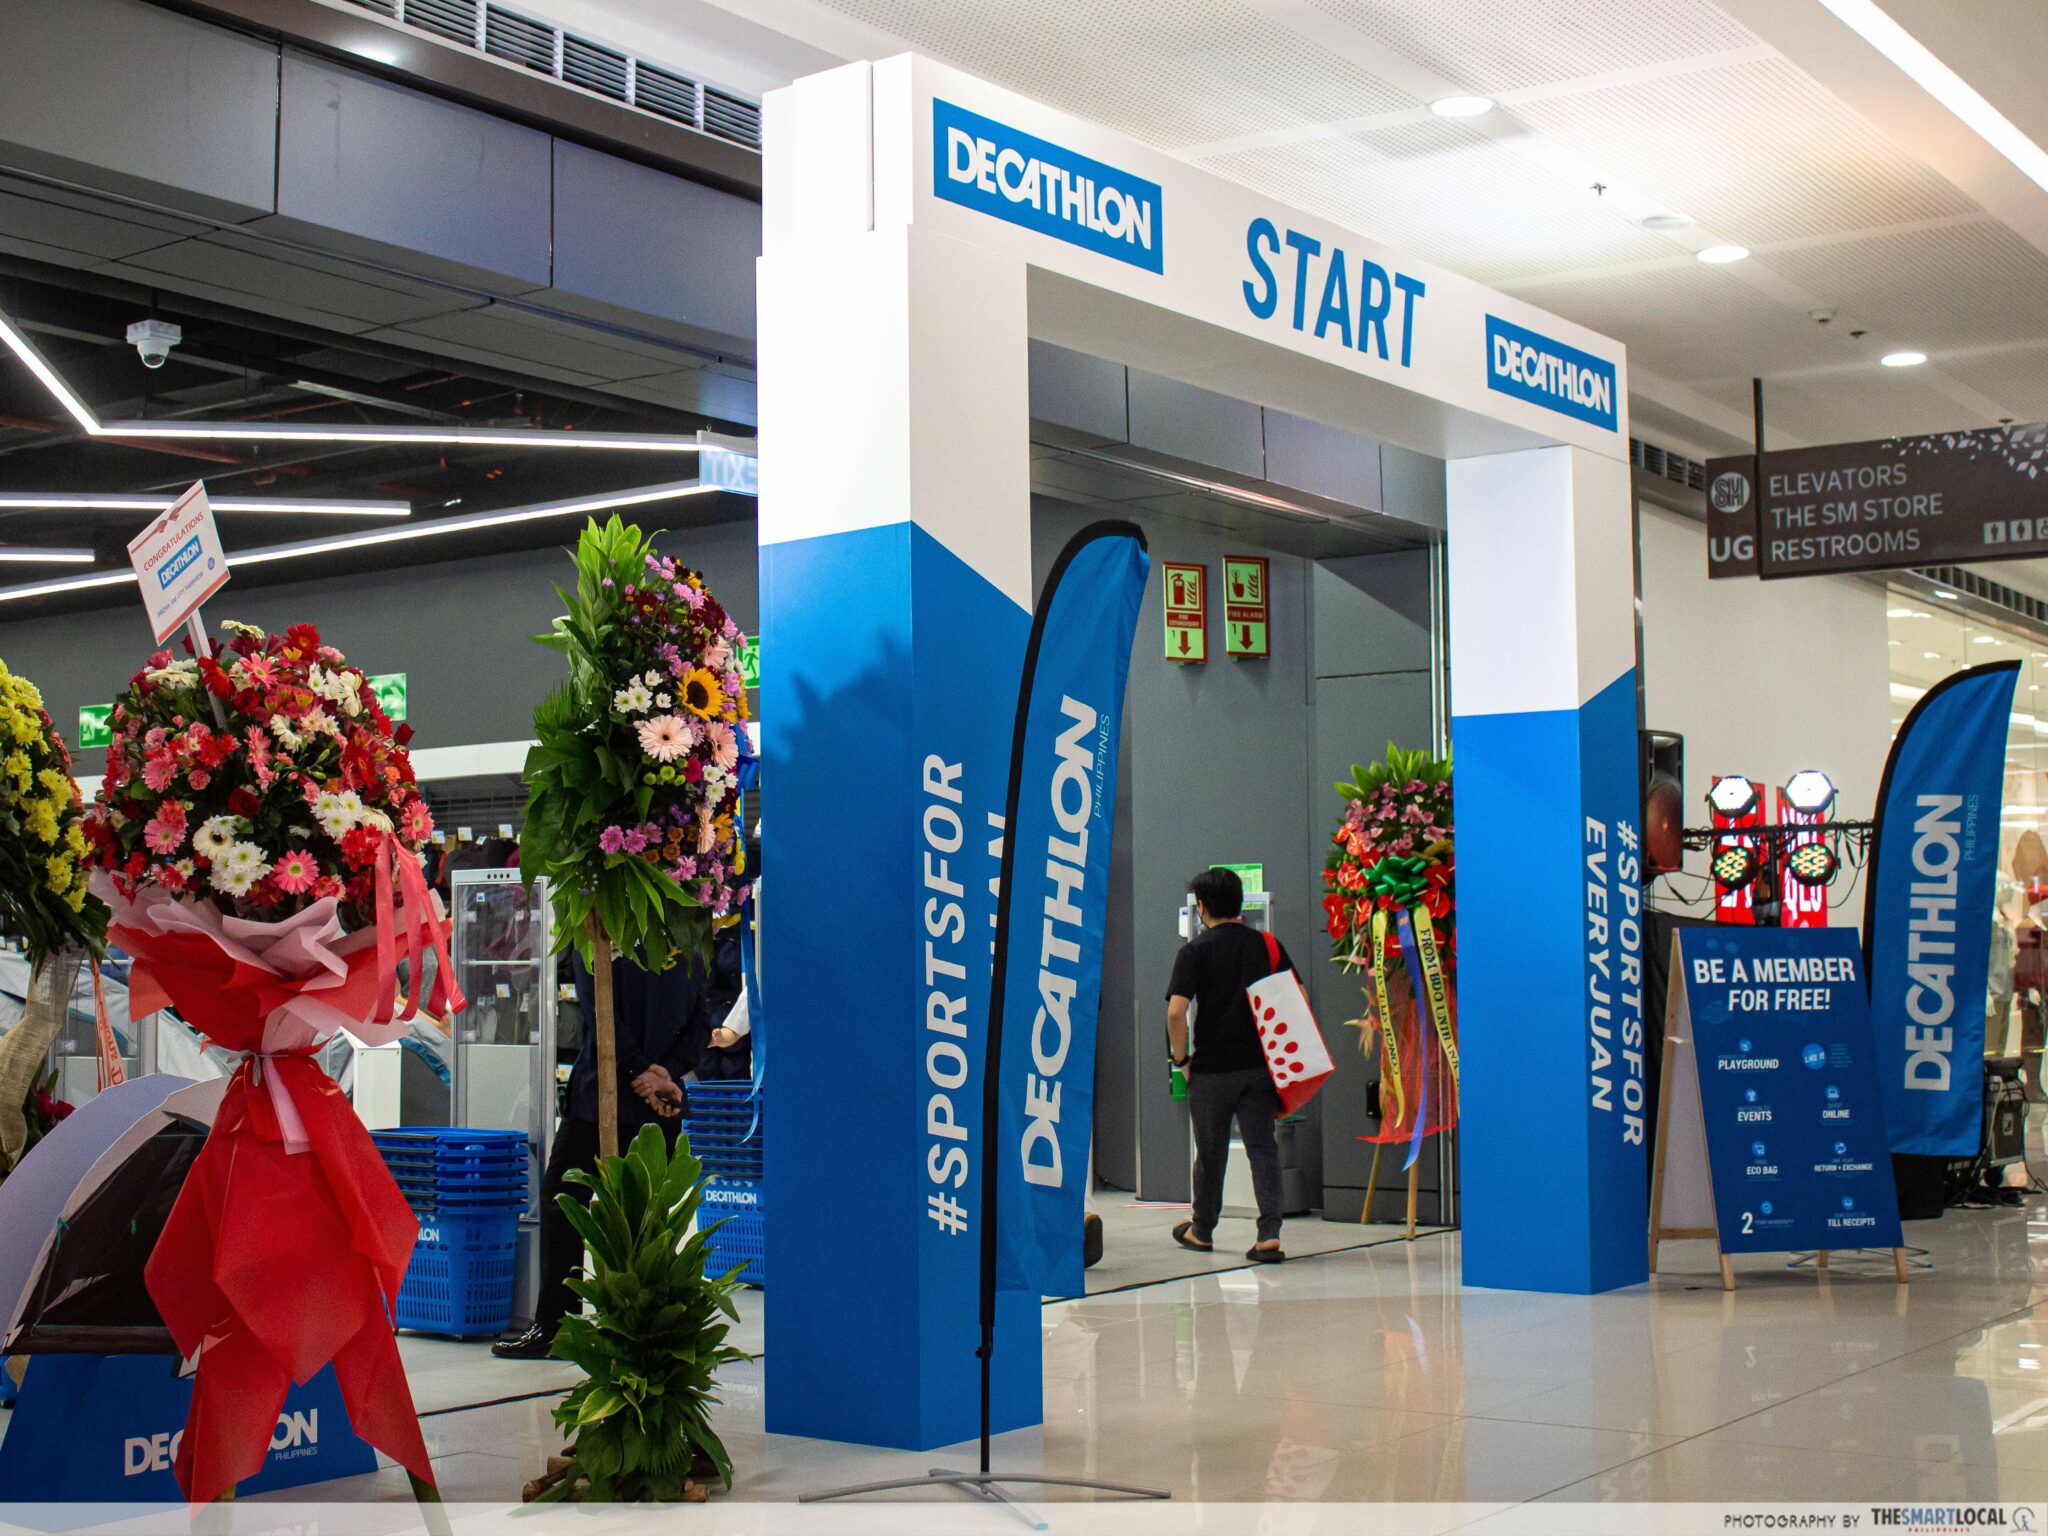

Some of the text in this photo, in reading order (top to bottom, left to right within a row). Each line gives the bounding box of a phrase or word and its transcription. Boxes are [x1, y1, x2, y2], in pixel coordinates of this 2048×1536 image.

[947, 126, 1153, 251] DECATHLON
[1242, 217, 1426, 369] START
[1494, 335, 1611, 415] DECATHLON
[1769, 464, 1908, 497] ELEVATORS
[1771, 493, 1944, 529] THE SM STORE
[144, 511, 204, 571] CONGRATULATIONS
[1710, 535, 1754, 562] UG
[1772, 528, 1921, 562] RESTROOMS
[161, 541, 199, 586] DECATHLON
[1093, 713, 1110, 818] PHILIPPINES
[1964, 793, 1979, 862] PHILIPPINES
[1021, 694, 1098, 1188] DECATHLON
[1904, 794, 1964, 1091] DECATHLON
[1421, 928, 1437, 970] FROM
[1430, 973, 1444, 1002] BDO
[1586, 816, 1613, 1112] EVERYJUAN
[1694, 957, 1856, 984] BE A MEMBER
[923, 754, 969, 1235] #SPORTSFOR
[1617, 820, 1644, 1145] #SPORTSFOR
[1728, 989, 1831, 1012] FOR FREE!
[1718, 1058, 1779, 1070] PLAYGROUND
[1738, 1110, 1772, 1122] EVENTS
[1822, 1109, 1850, 1118] ONLINE
[1747, 1166, 1778, 1175] ECO BAG
[1814, 1164, 1837, 1172] RETURN
[1842, 1163, 1873, 1171] EXCHANGE
[705, 1189, 757, 1204] DECATHLON
[1741, 1212, 1754, 1234] 2
[1828, 1217, 1876, 1227] TILL RECEIPTS
[275, 1446, 318, 1461] PHILIPPINES
